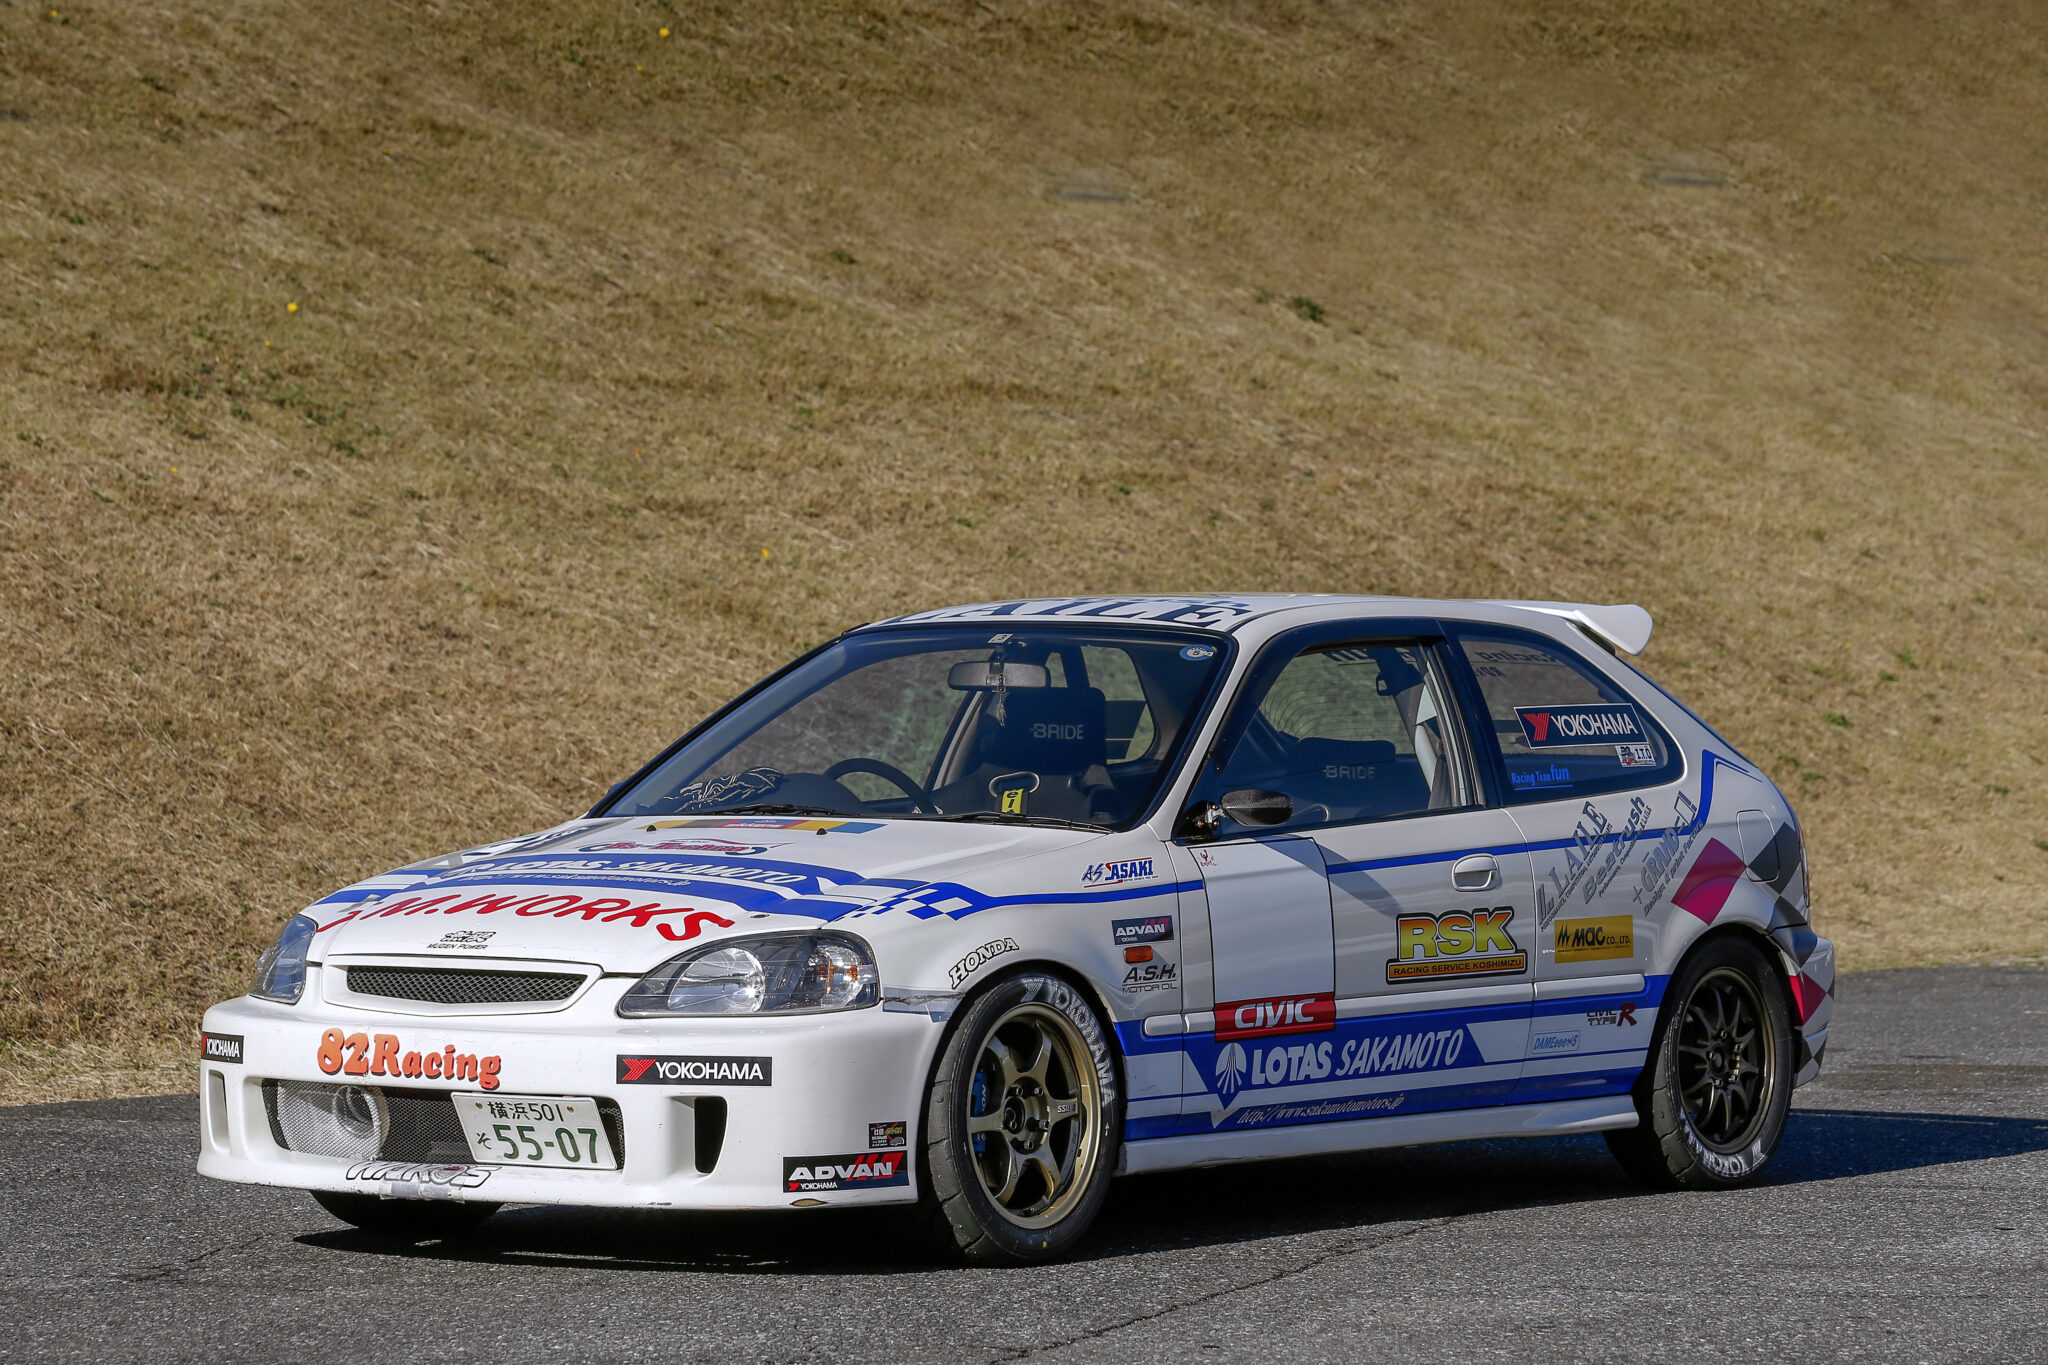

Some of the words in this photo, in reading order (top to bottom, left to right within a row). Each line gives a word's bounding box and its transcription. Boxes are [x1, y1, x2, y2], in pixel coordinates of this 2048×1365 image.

[1032, 724, 1084, 740] BRIDE
[1551, 713, 1638, 736] YOKOHAMA
[1325, 765, 1375, 780] BRIDE
[1512, 772, 1535, 787] Racing
[1550, 764, 1570, 781] fun
[1582, 795, 1645, 904] Beatrush
[489, 860, 612, 871] LOTAS
[603, 861, 808, 884] SAKAMOTO
[1115, 923, 1166, 937] ADVAN
[1399, 911, 1515, 960] RSK
[949, 937, 1020, 989] HONDA
[1393, 965, 1430, 976] RACING
[1431, 962, 1471, 973] SERVICE
[1472, 958, 1522, 970] KOSHIMIZU
[1122, 985, 1160, 994] MOTOR
[1161, 983, 1178, 991] OIL
[1234, 998, 1317, 1029] CIVIC
[1586, 1008, 1617, 1018] CIVIC
[1587, 1017, 1617, 1026] TYPE
[1617, 1003, 1638, 1026] R
[206, 1038, 241, 1058] YOKOHAMA
[317, 1027, 501, 1090] 82Racing
[1251, 1041, 1334, 1086] LOTAS
[1335, 1028, 1465, 1076] SAKAMOTO
[655, 1061, 764, 1081] YOKOHAMA
[475, 1132, 492, 1150] そ
[492, 1123, 599, 1164] 55-07
[788, 1162, 894, 1181] ADVAN
[800, 1181, 838, 1190] YOKOHAMA
